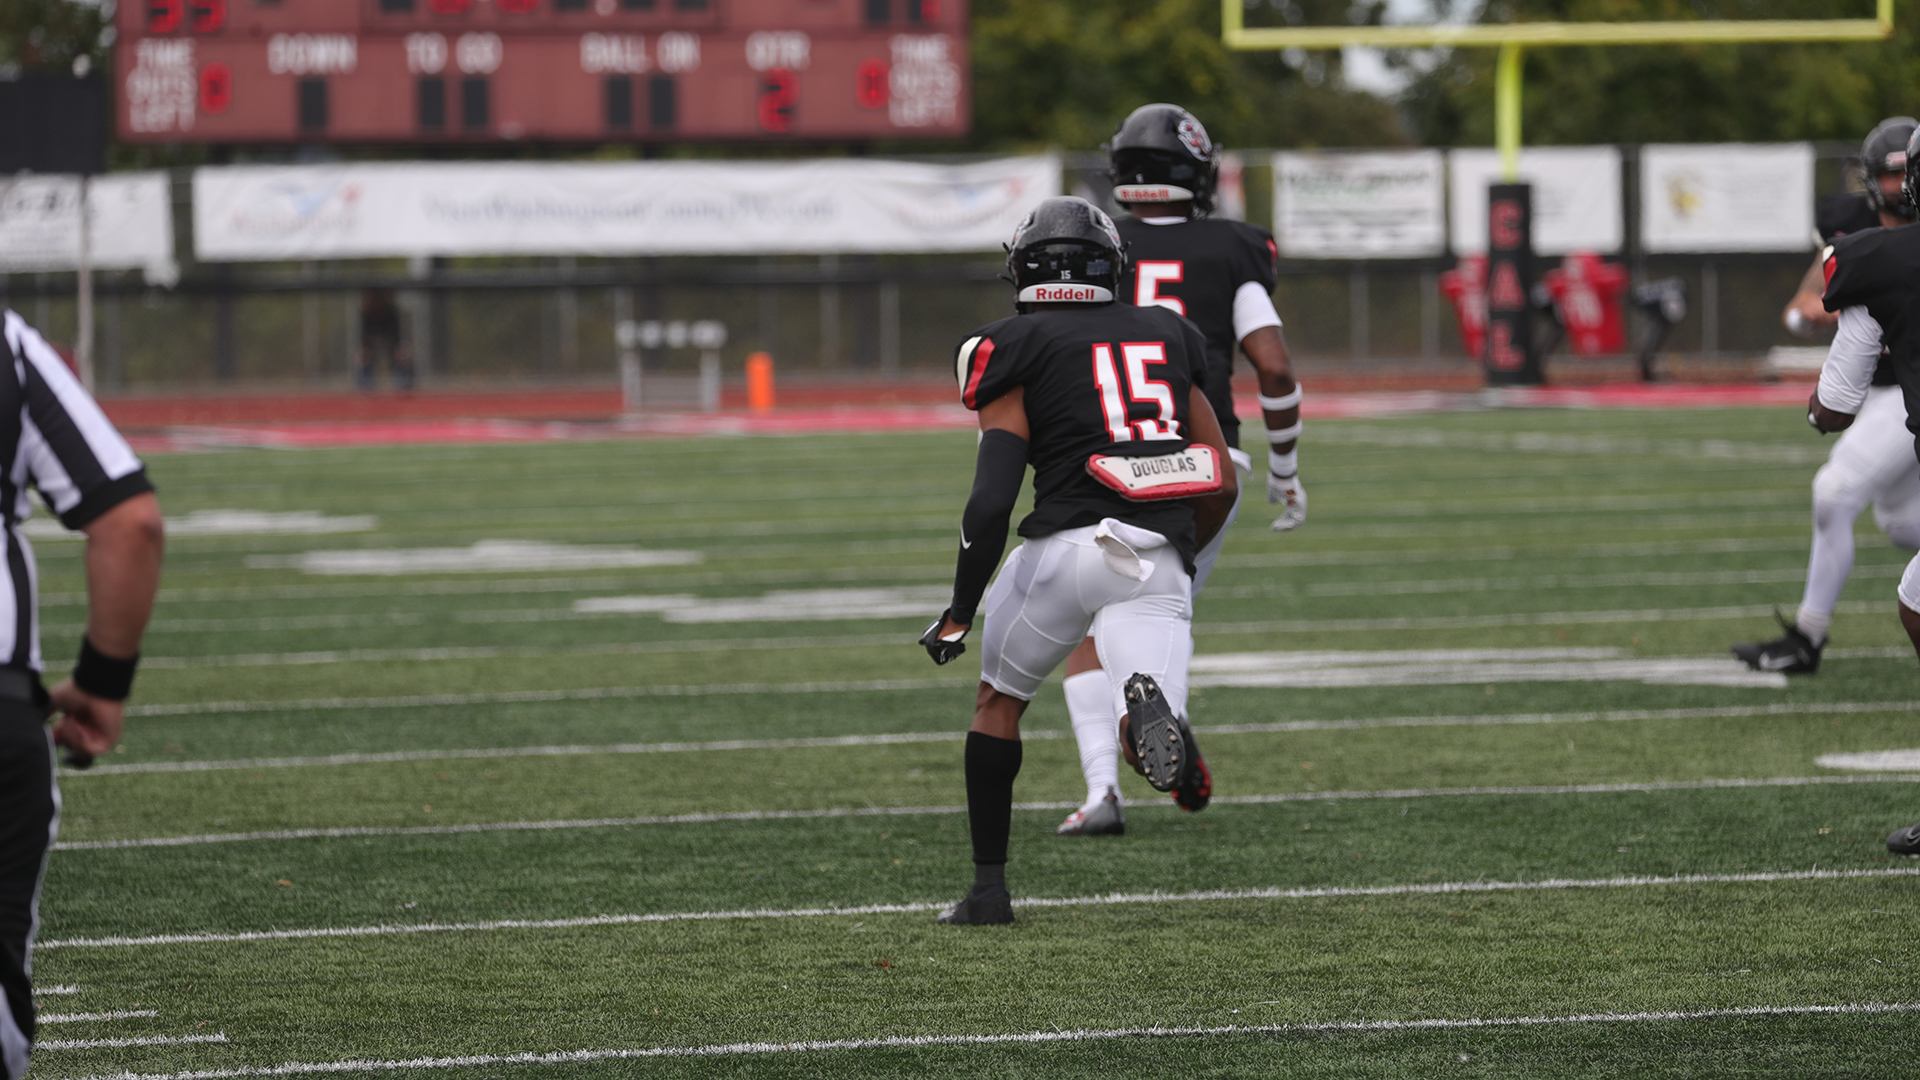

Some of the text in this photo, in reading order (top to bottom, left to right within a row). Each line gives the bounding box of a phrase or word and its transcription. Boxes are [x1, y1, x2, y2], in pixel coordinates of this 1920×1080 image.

[137, 39, 196, 69] TIME
[268, 33, 358, 74] DOWN
[405, 32, 502, 74] TO GO
[580, 32, 699, 73] BALL ON
[889, 34, 950, 63] TIME
[127, 67, 197, 104] OUTS
[889, 62, 960, 99] OUTS
[130, 102, 195, 133] LEFT
[758, 68, 798, 132] 2
[889, 98, 956, 127] LEFT
[1121, 188, 1169, 201] Riddell
[1061, 270, 1071, 280] 15
[1133, 259, 1187, 318] 5
[1490, 200, 1525, 372] CAL
[1035, 288, 1095, 301] Riddell
[1092, 341, 1185, 443] 15
[1131, 456, 1197, 478] DOUGLAS
